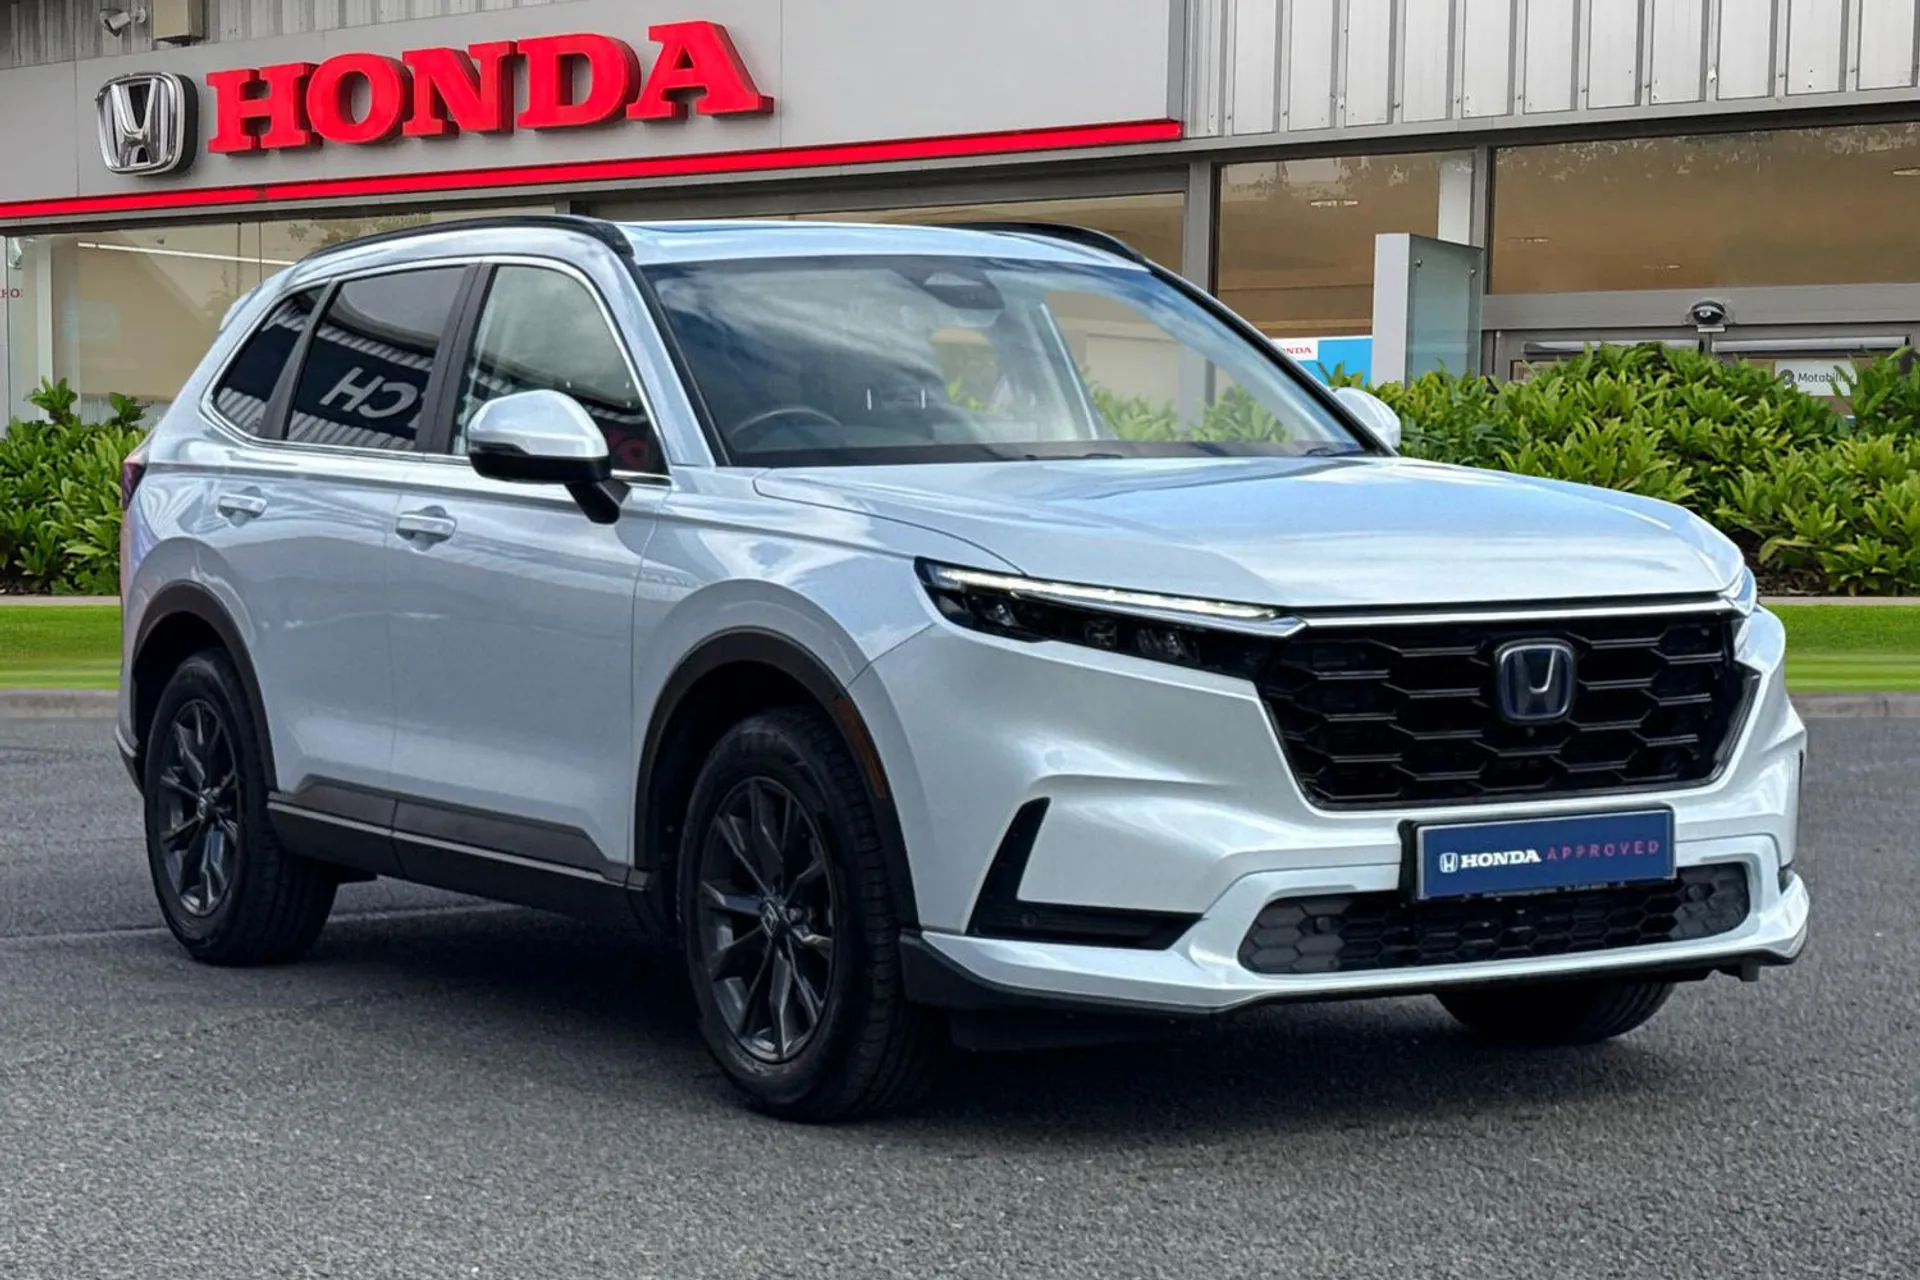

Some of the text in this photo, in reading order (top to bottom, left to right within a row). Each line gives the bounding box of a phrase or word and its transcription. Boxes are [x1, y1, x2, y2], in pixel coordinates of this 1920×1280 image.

[206, 20, 774, 153] HONDA
[1461, 840, 1660, 869] HONDA APPROVED
